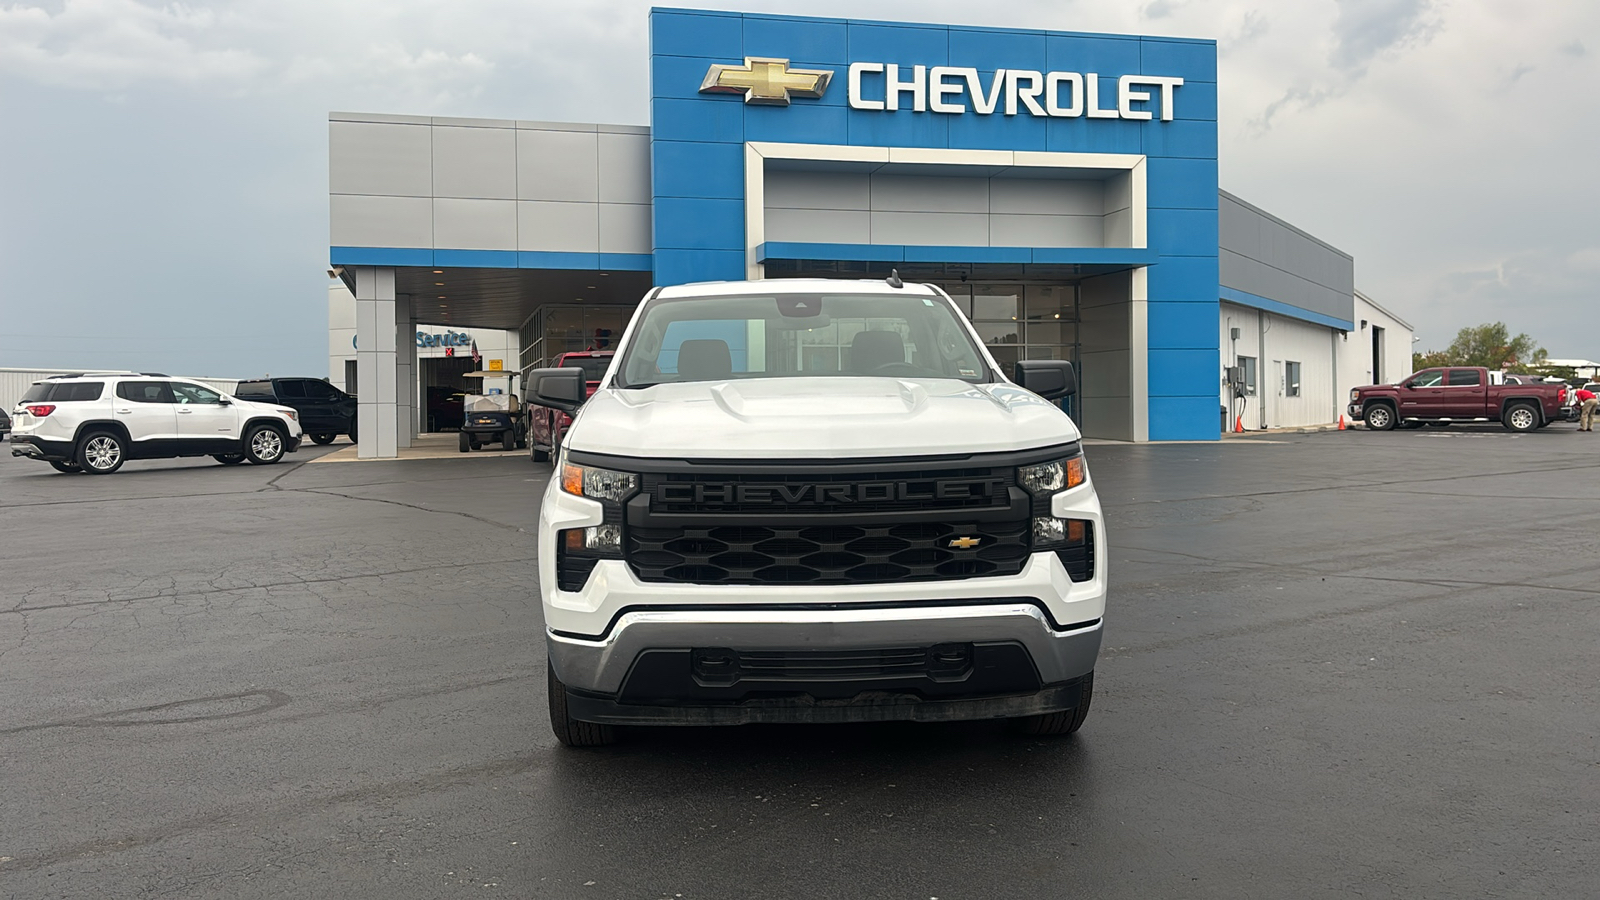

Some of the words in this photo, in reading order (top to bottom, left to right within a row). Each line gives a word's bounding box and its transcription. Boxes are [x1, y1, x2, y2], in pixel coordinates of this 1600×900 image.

[848, 61, 1184, 121] CHEVROLET
[416, 329, 469, 347] Service
[657, 477, 1005, 503] CHEVROLET
